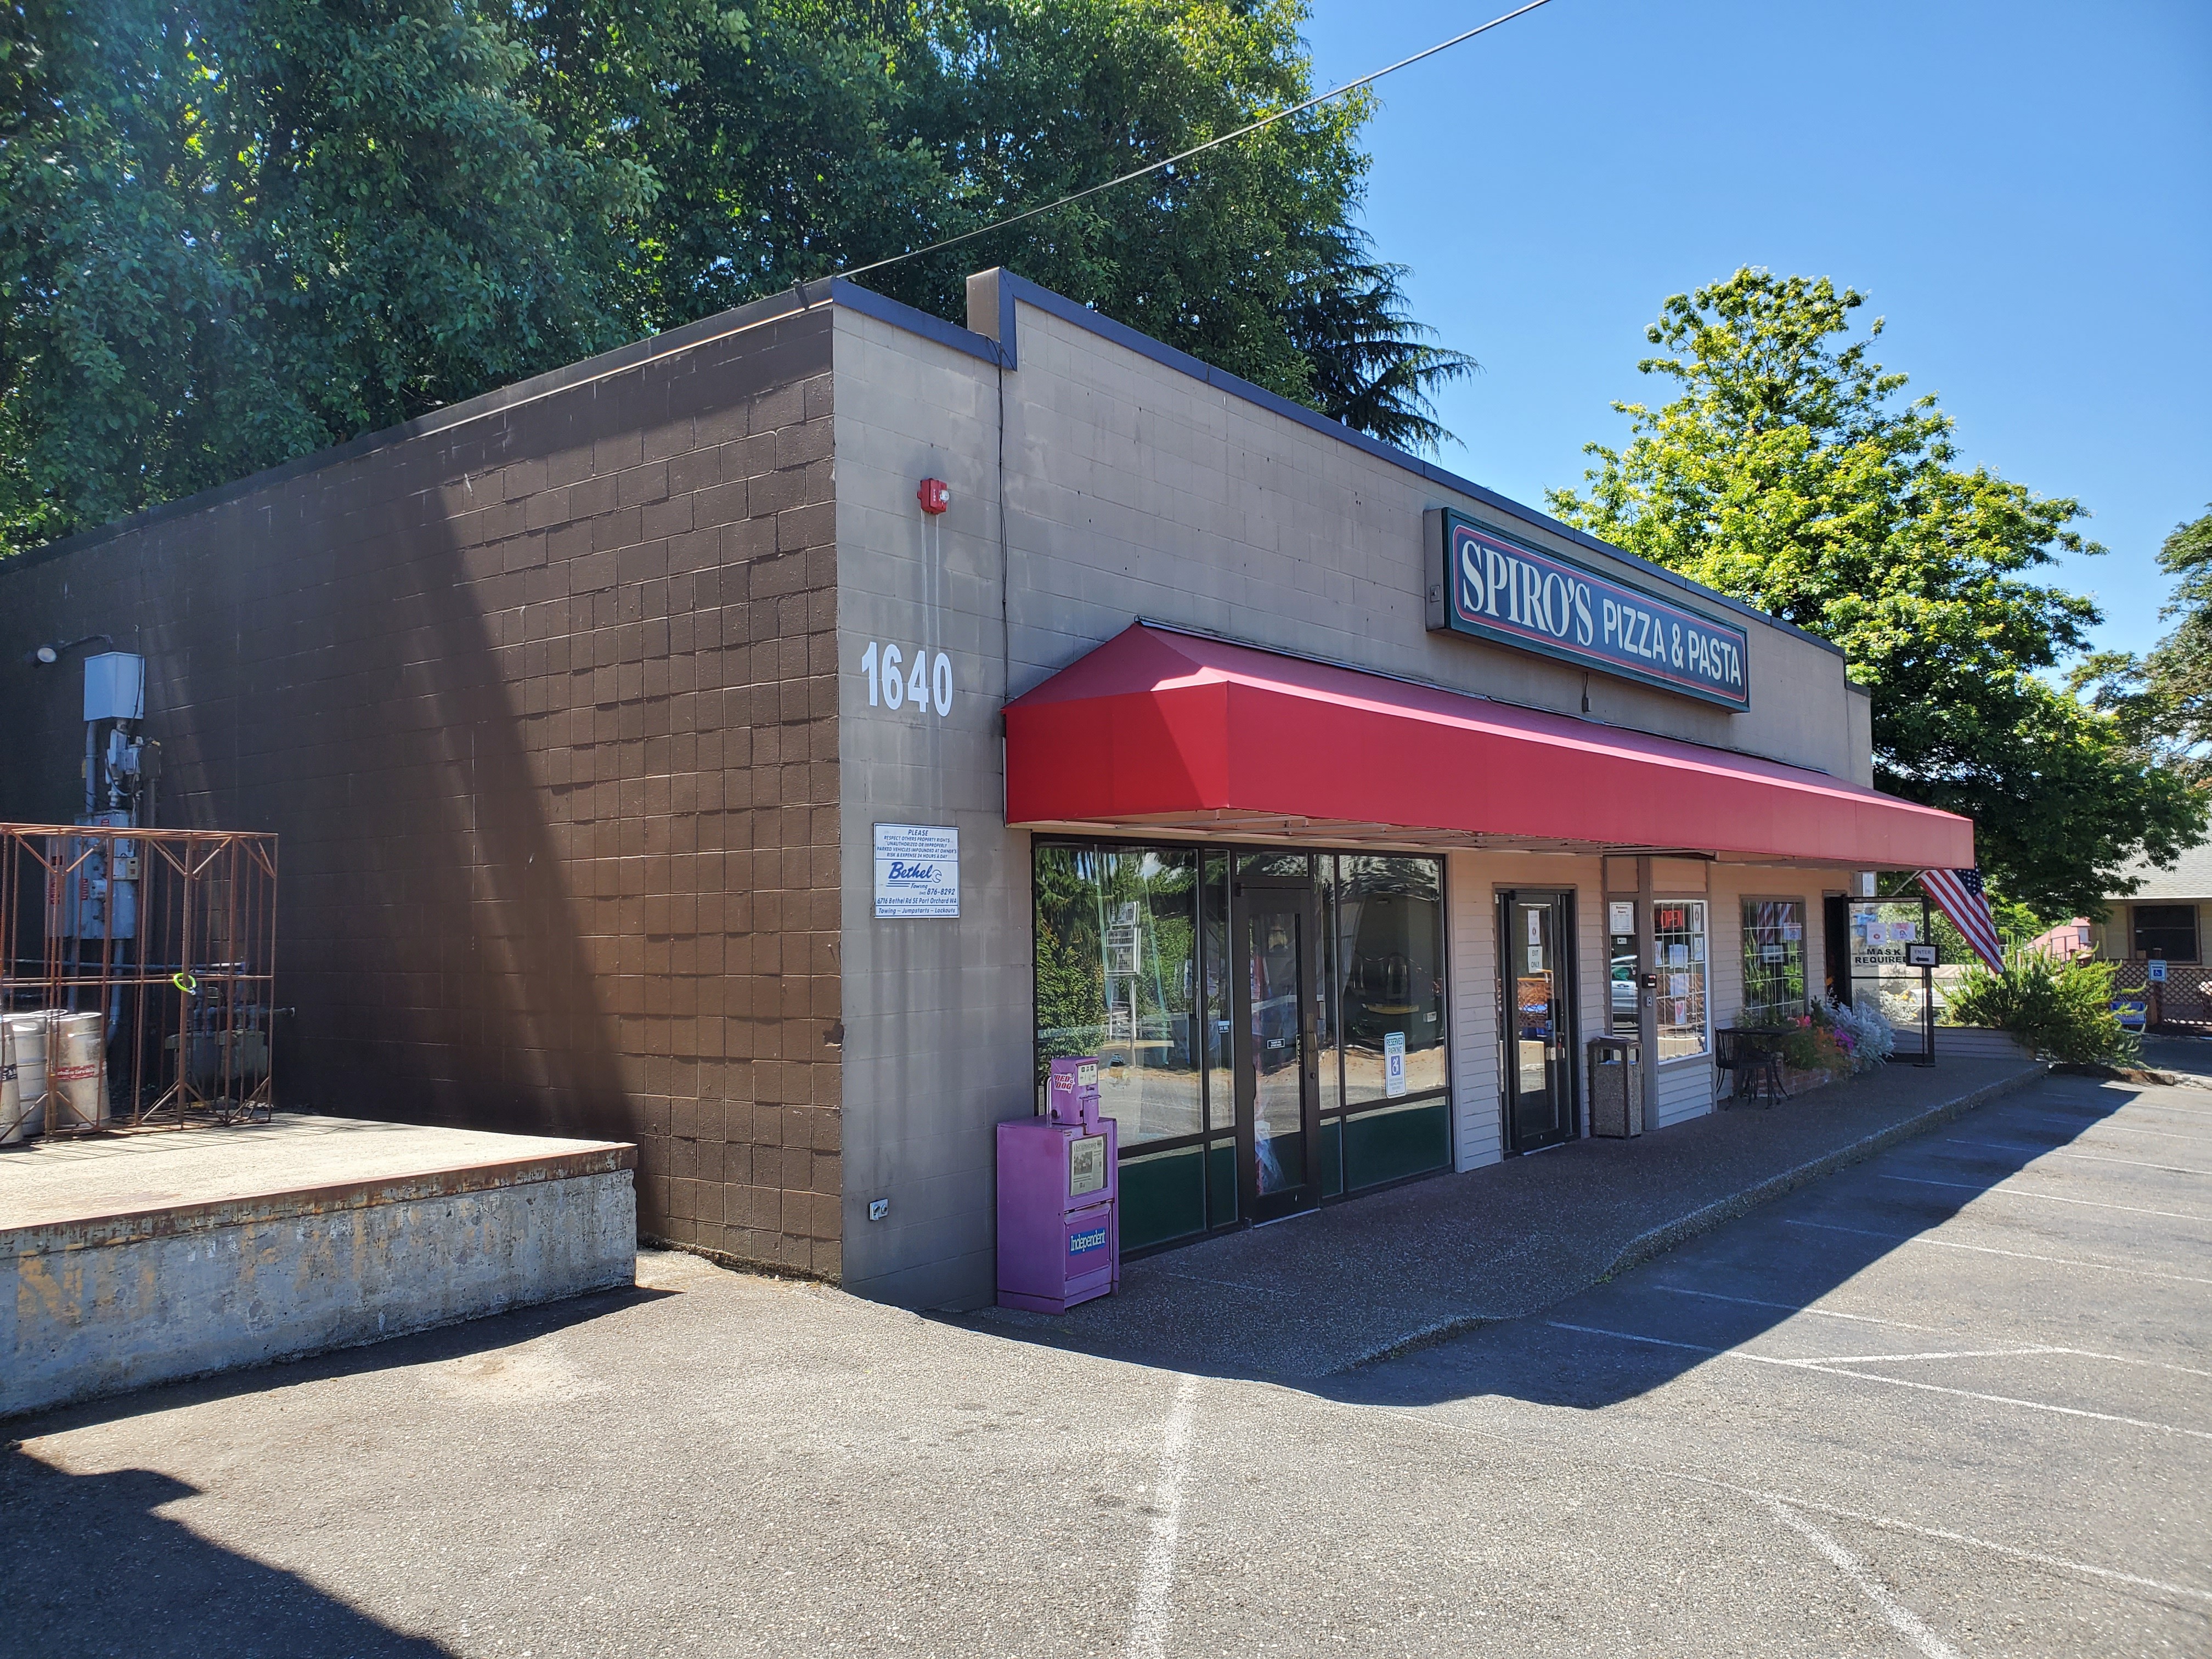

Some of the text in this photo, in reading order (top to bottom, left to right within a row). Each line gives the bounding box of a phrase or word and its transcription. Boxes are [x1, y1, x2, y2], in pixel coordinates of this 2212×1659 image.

[1462, 540, 1741, 686] SPIRO'S PIZZA & PASTA
[862, 641, 952, 717] 1640
[888, 861, 933, 879] Bethel
[1661, 910, 1683, 928] OPEN
[1386, 1037, 1403, 1046] RESERVED
[1388, 1046, 1402, 1055] PARKING
[1070, 1229, 1105, 1252] Independent
